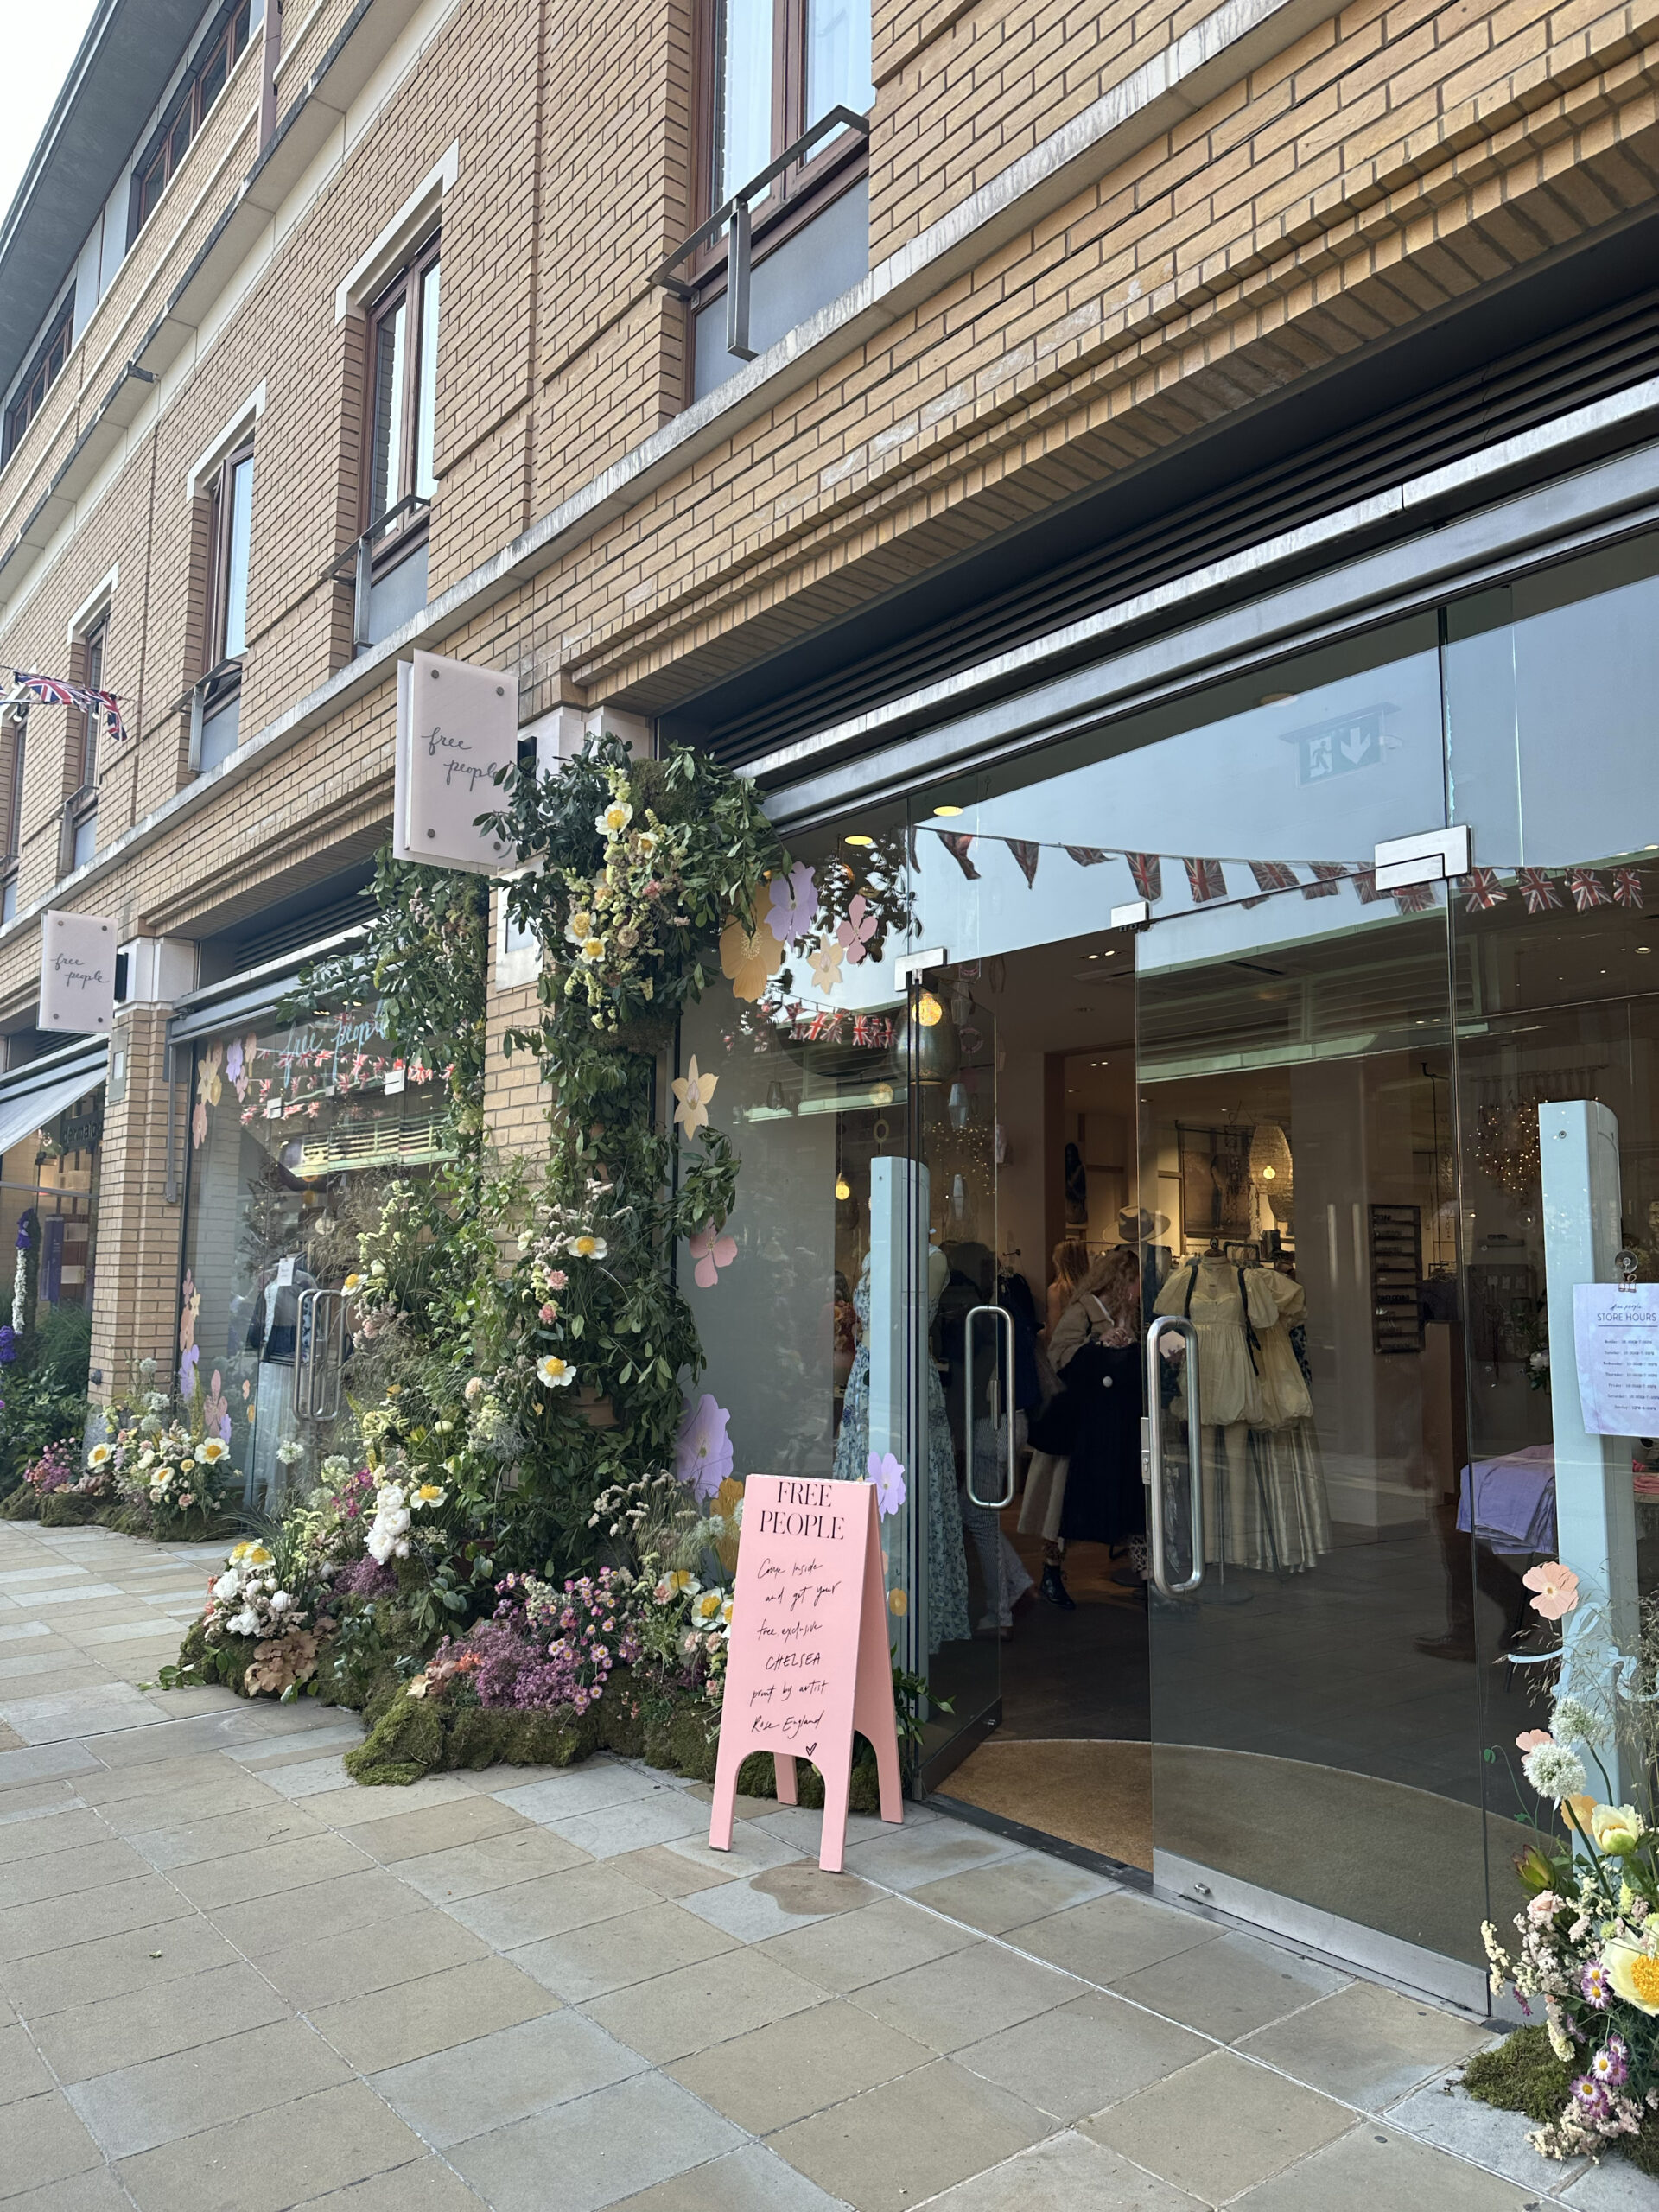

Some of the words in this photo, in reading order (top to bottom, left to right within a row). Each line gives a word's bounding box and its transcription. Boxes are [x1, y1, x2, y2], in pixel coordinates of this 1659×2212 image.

[421, 727, 473, 756] free
[50, 953, 86, 971] free
[65, 970, 110, 990] people
[1597, 1313, 1624, 1322] STORE
[1625, 1313, 1657, 1322] HOURS
[778, 1481, 832, 1508] FREE
[760, 1510, 845, 1541] PEOPLE
[758, 1558, 786, 1579] Come
[765, 1586, 785, 1605] and
[790, 1586, 813, 1611] get
[813, 1581, 842, 1607] your
[757, 1618, 777, 1641] free
[781, 1621, 823, 1644] exclusive
[765, 1651, 821, 1671] CHELSEA
[749, 1684, 777, 1707] print
[780, 1682, 793, 1702] by
[798, 1680, 830, 1695] artist
[751, 1714, 780, 1733] Rose
[782, 1709, 825, 1740] England
